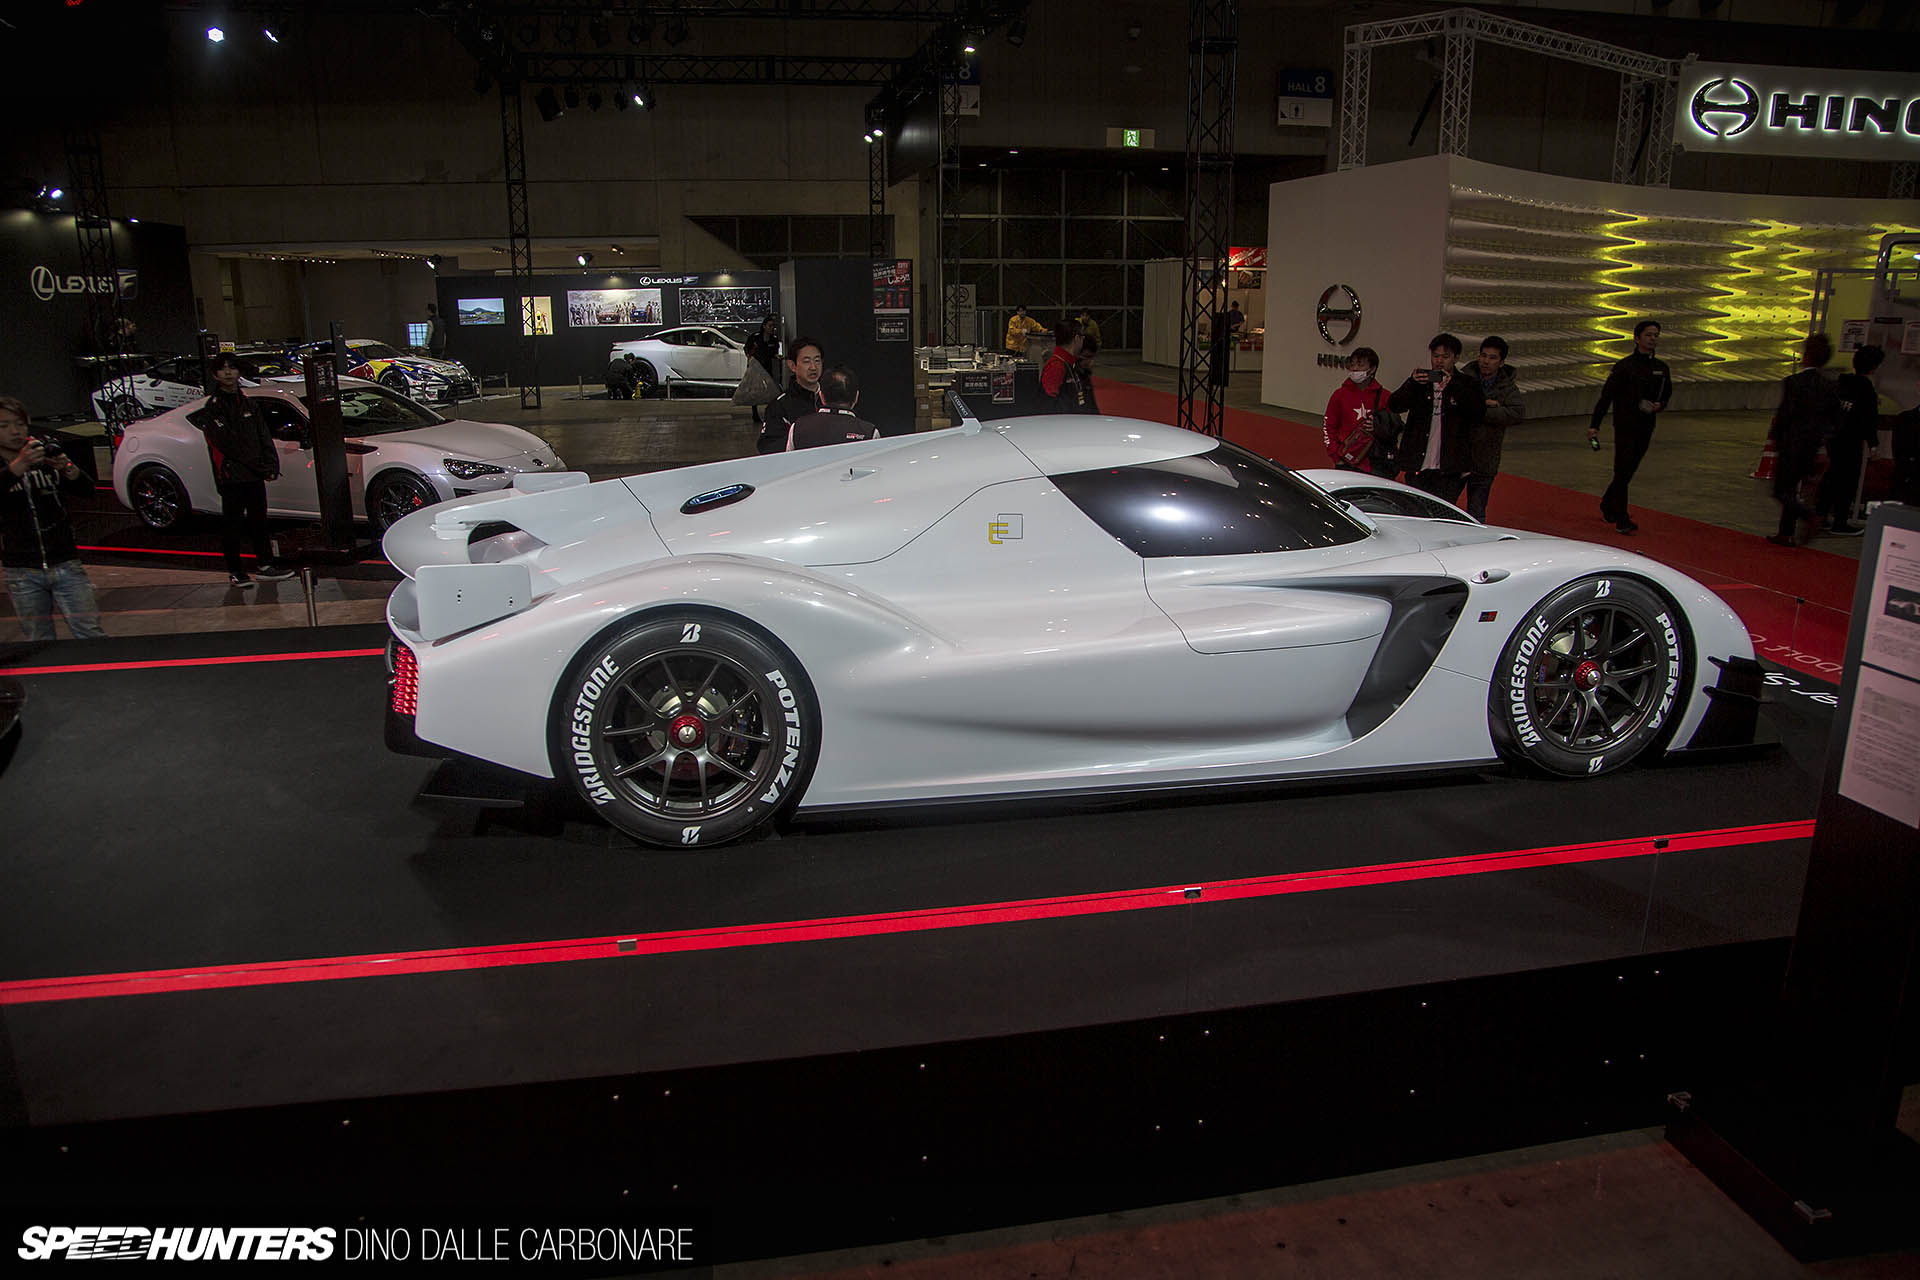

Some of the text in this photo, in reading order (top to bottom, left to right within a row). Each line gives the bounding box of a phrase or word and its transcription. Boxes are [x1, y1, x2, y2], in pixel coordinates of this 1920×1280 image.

[1287, 75, 1327, 94] HALL 8
[652, 277, 683, 285] LEXUS
[187, 388, 201, 396] DEN
[1510, 614, 1550, 748] BRIDGESTONE
[1647, 612, 1680, 729] POTENZA
[571, 654, 621, 805] BRIDGESTONE
[760, 669, 801, 804] POTENZA
